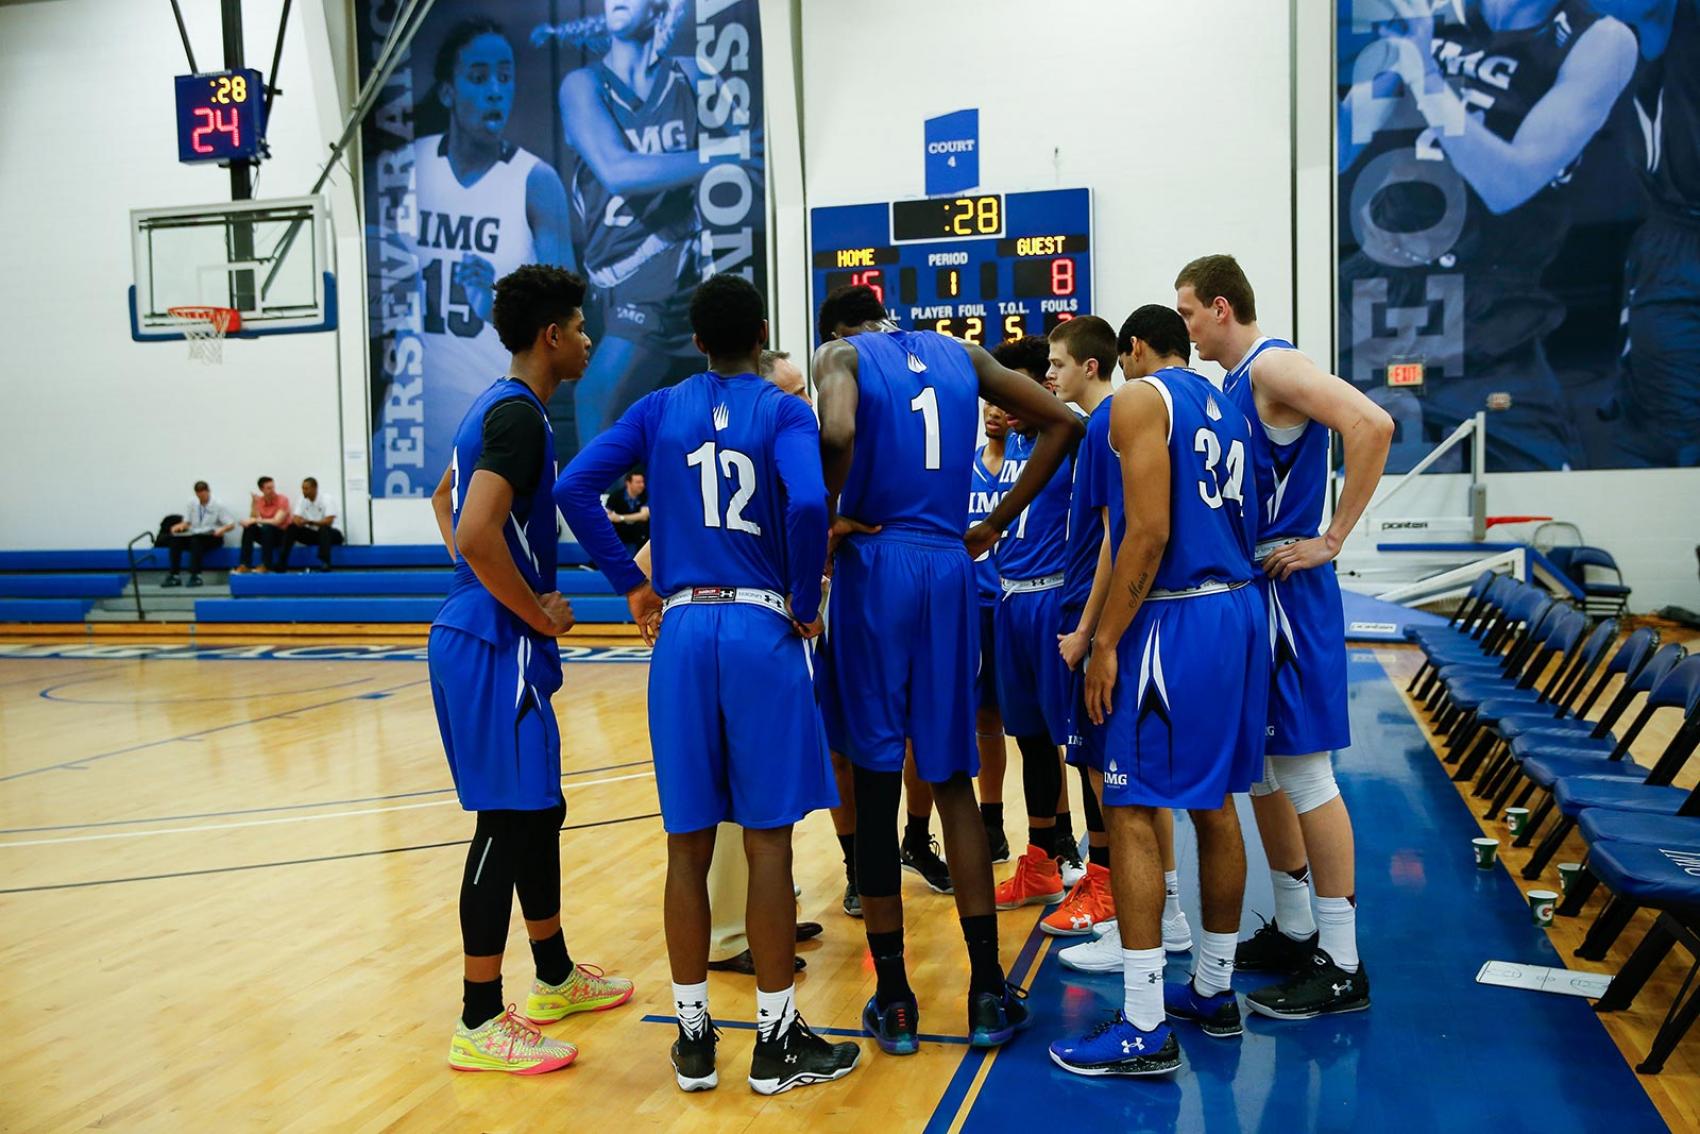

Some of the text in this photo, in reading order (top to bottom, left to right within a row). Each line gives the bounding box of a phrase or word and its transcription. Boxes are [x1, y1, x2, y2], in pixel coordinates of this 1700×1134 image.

[192, 107, 240, 154] 24
[928, 139, 976, 154] COURT
[947, 155, 957, 167] 4
[416, 210, 501, 254] IMG
[1016, 235, 1066, 256] GUEST
[837, 248, 876, 268] HOME
[928, 252, 968, 267] PERIOD
[950, 271, 958, 296] 1
[1052, 258, 1074, 295] 8
[421, 258, 485, 338] 15
[998, 301, 1030, 315] T.O.L.
[1041, 298, 1078, 313] FOULS
[910, 305, 953, 320] PLAYER
[958, 303, 987, 318] FOUL
[1394, 366, 1417, 383] EXIT
[911, 386, 940, 470] 1
[1194, 427, 1244, 518] 34
[686, 441, 761, 536] 12
[1104, 771, 1128, 785] IMG
